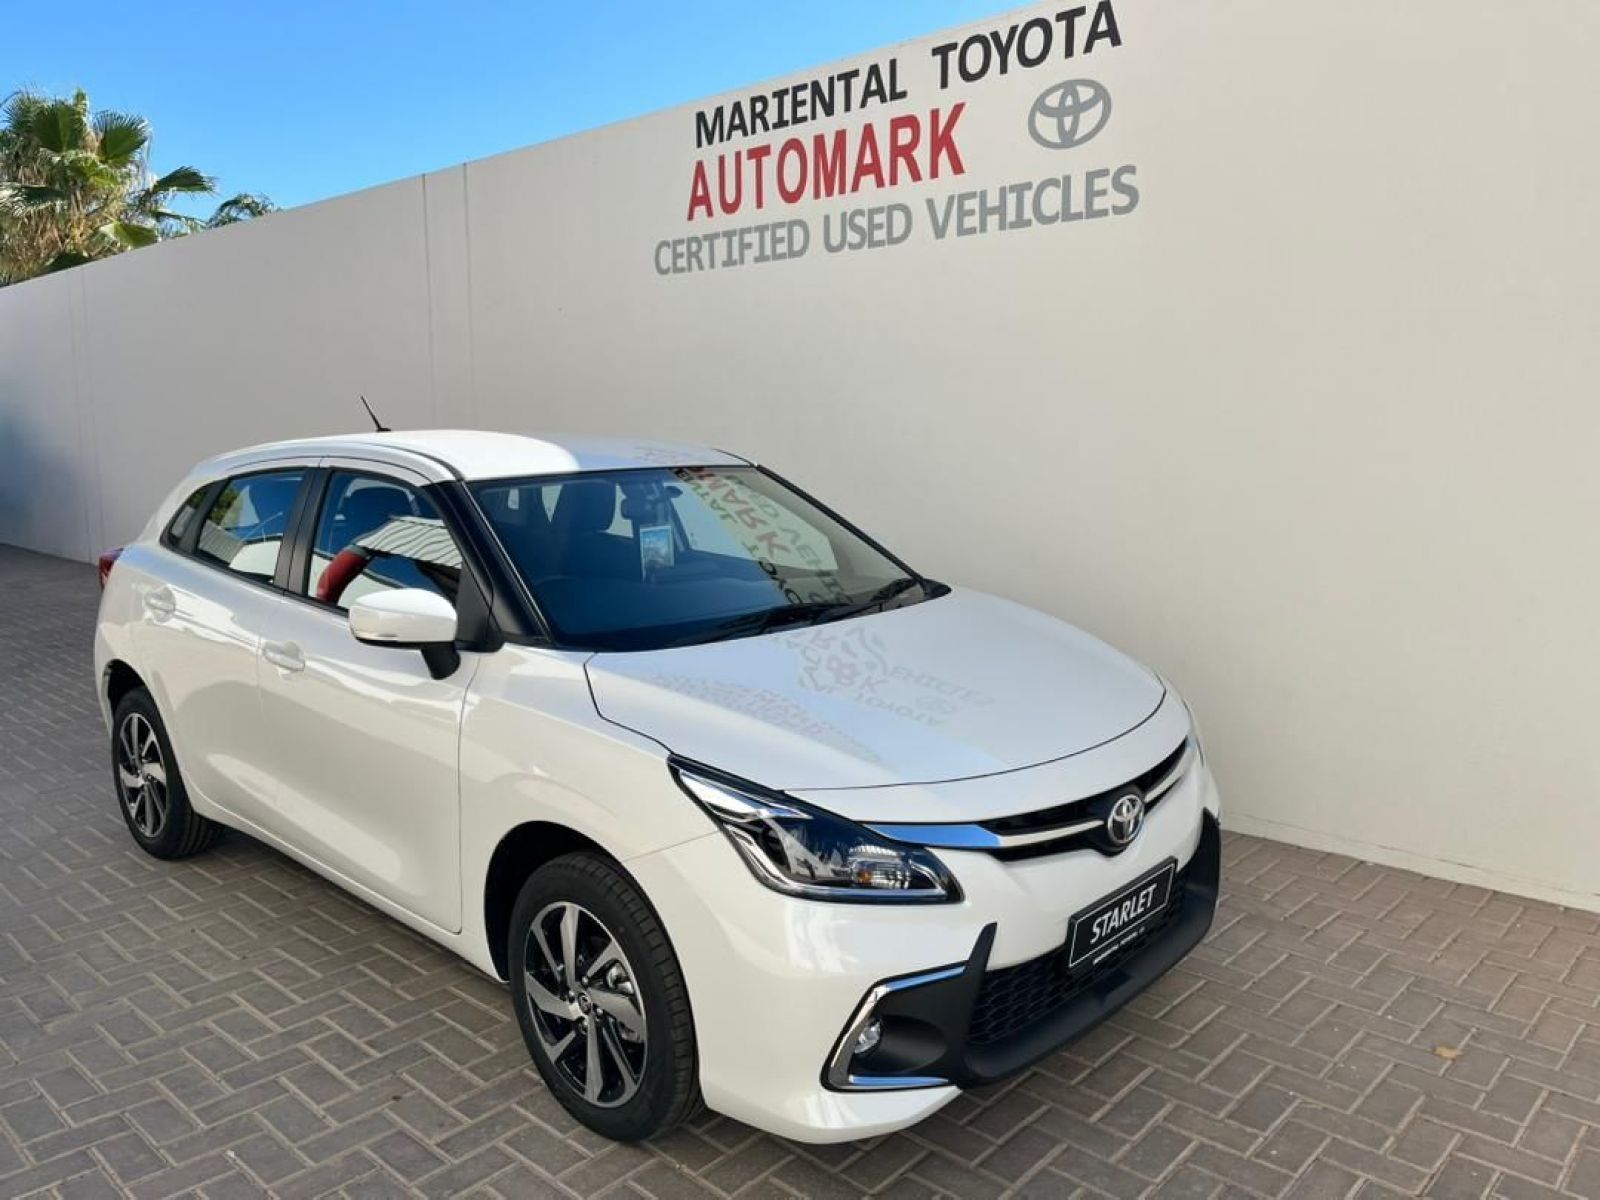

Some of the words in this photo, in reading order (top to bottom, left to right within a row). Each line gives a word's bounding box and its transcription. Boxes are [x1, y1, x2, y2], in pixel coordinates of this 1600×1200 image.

[696, 58, 907, 148] MARIENTAL
[931, 0, 1122, 89] TOYOTA
[687, 102, 966, 221] AUTOMARK
[654, 218, 810, 276] CERTIFIED
[824, 203, 912, 254] USED
[925, 165, 1139, 240] VEHICLES
[1090, 883, 1157, 944] STARLET
